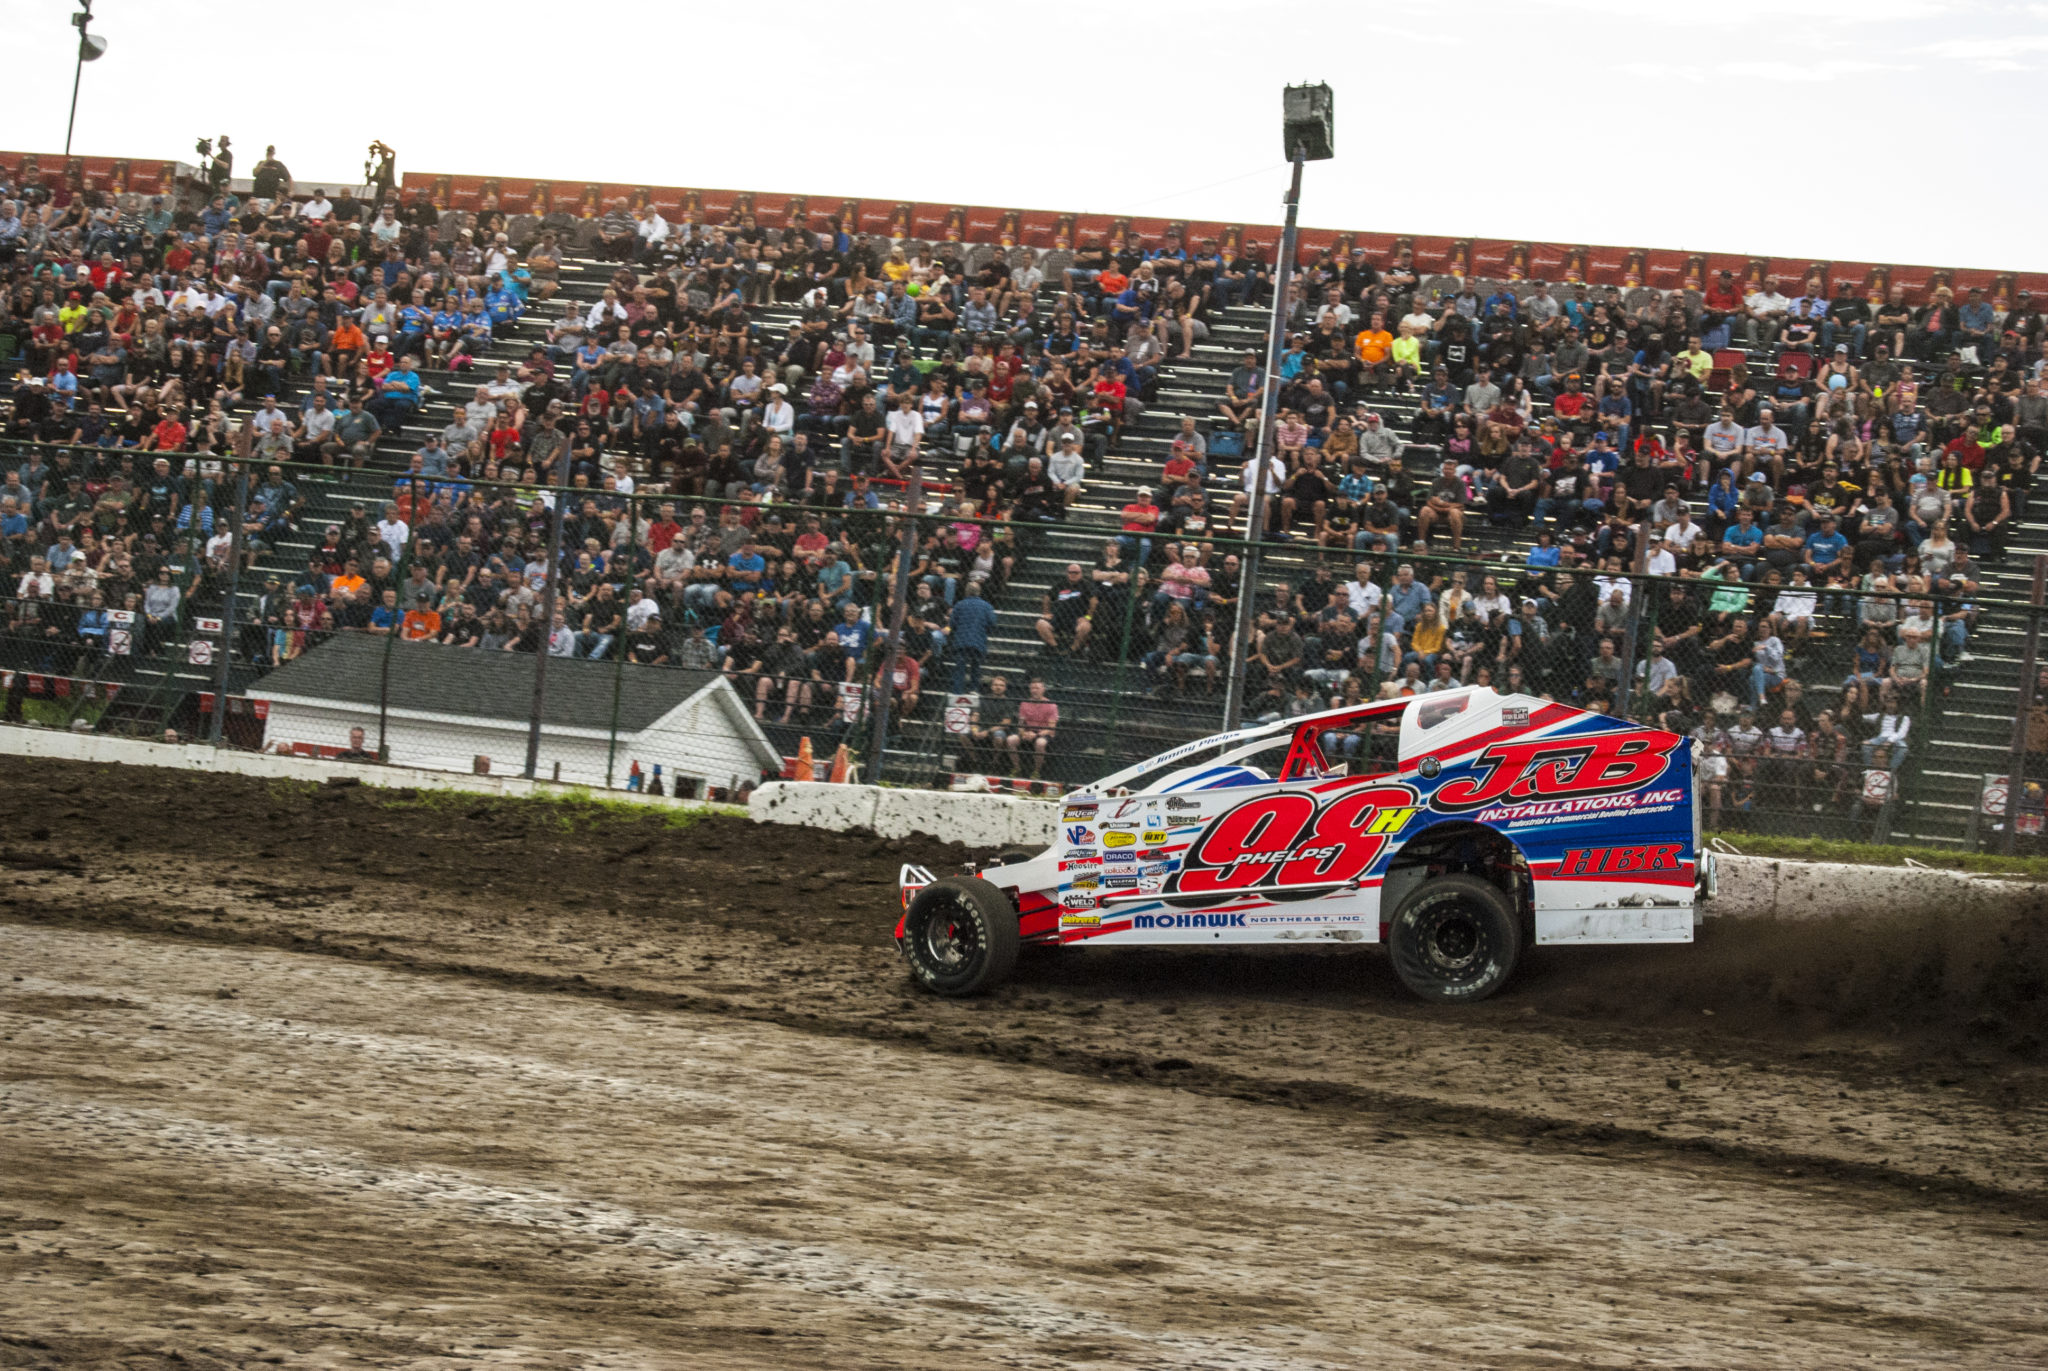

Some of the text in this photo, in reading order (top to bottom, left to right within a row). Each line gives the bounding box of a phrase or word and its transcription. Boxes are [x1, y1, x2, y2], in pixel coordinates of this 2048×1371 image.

[203, 621, 219, 629] B
[1431, 730, 1682, 812] J&B
[1476, 788, 1684, 821] INSTALLATIONS, INC.
[1508, 817, 1546, 828] Industrial
[1552, 811, 1600, 824] Commercial
[1598, 809, 1628, 819] Roofing
[1628, 804, 1674, 815] Contractors
[1364, 807, 1419, 834] H
[1067, 826, 1087, 845] VP
[1163, 785, 1418, 907] 98
[1105, 853, 1134, 861] DRACO
[1231, 846, 1336, 866] PHELPS
[1552, 843, 1685, 876] HBR
[1133, 913, 1248, 928] MOHAWK
